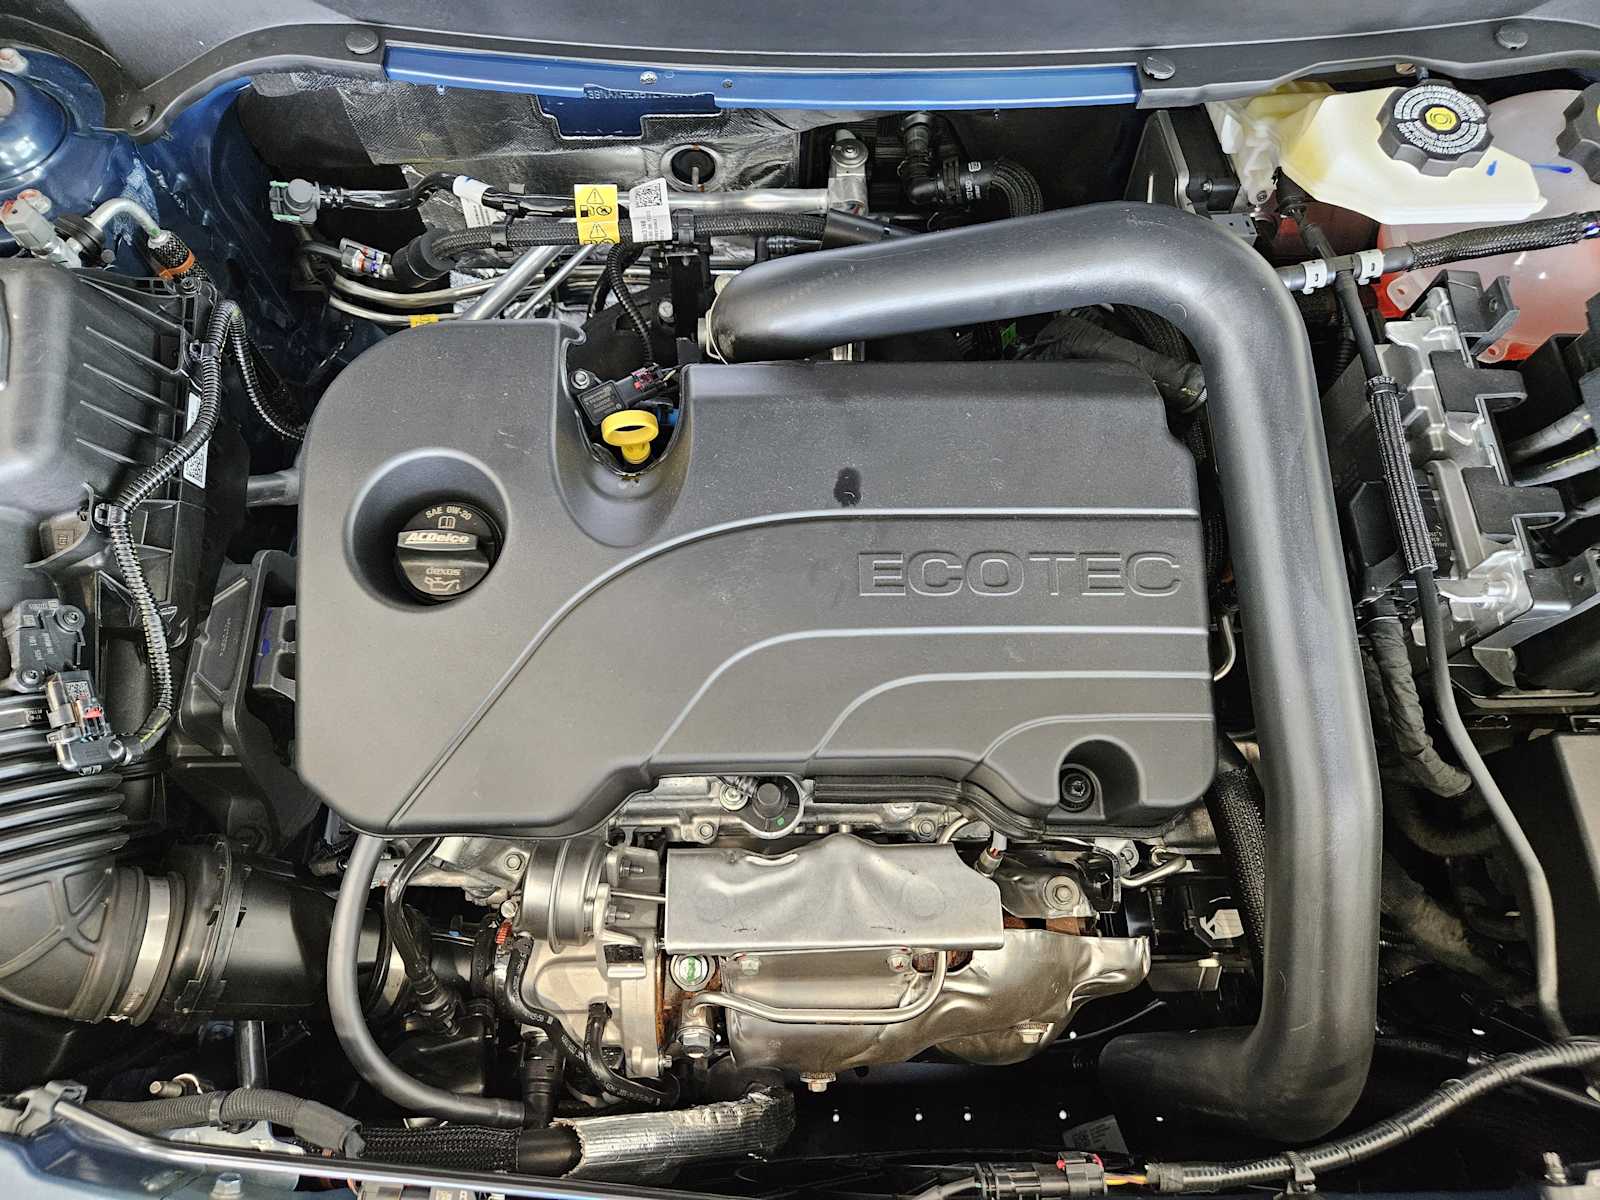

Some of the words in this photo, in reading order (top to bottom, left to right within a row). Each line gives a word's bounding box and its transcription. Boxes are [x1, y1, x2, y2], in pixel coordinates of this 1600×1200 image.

[425, 507, 442, 518] SAE
[446, 506, 472, 520] 0W-20
[405, 533, 470, 544] ACDelco
[425, 567, 461, 576] dexos
[858, 551, 1181, 597] ECOTEC
